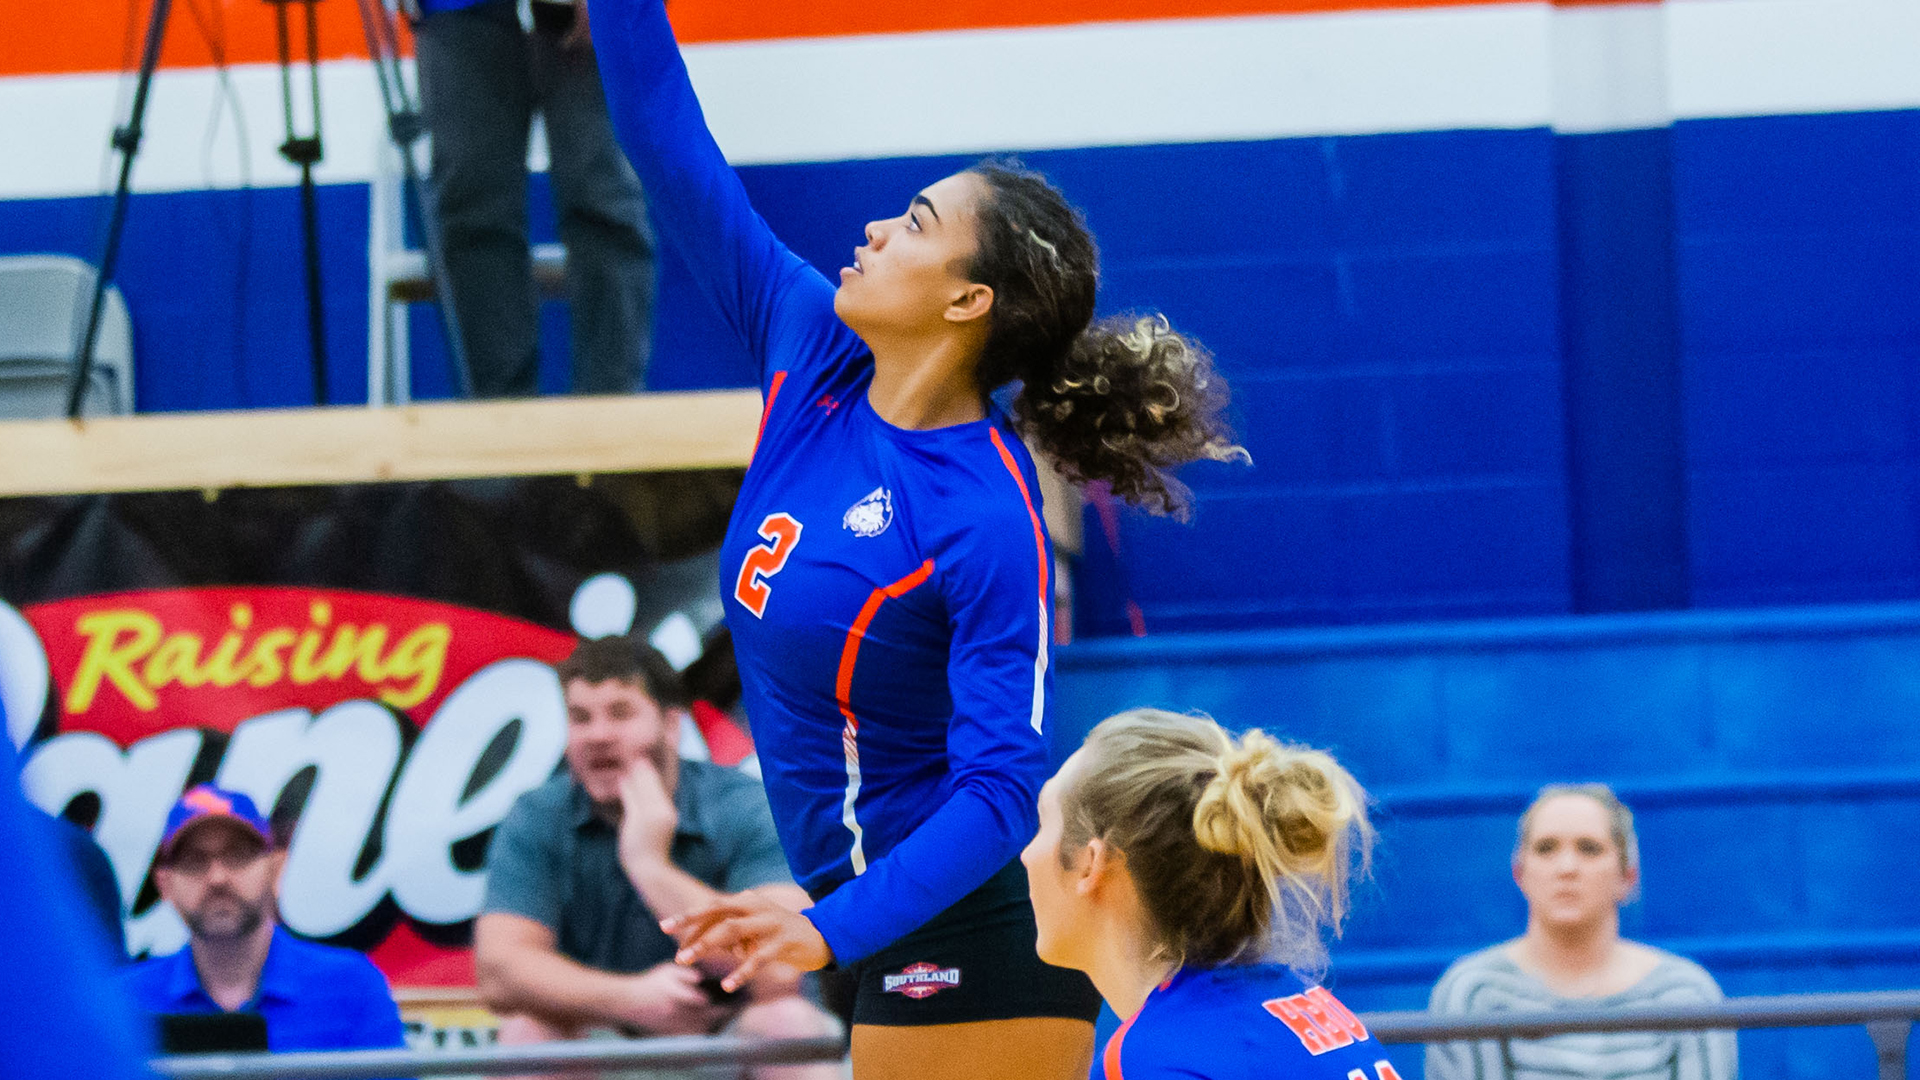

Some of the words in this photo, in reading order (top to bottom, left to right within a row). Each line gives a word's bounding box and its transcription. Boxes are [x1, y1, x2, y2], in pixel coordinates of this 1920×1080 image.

[734, 512, 804, 620] 2
[65, 601, 452, 714] Raising
[884, 966, 960, 992] SOUTHLAND
[1261, 985, 1370, 1057] HBU
